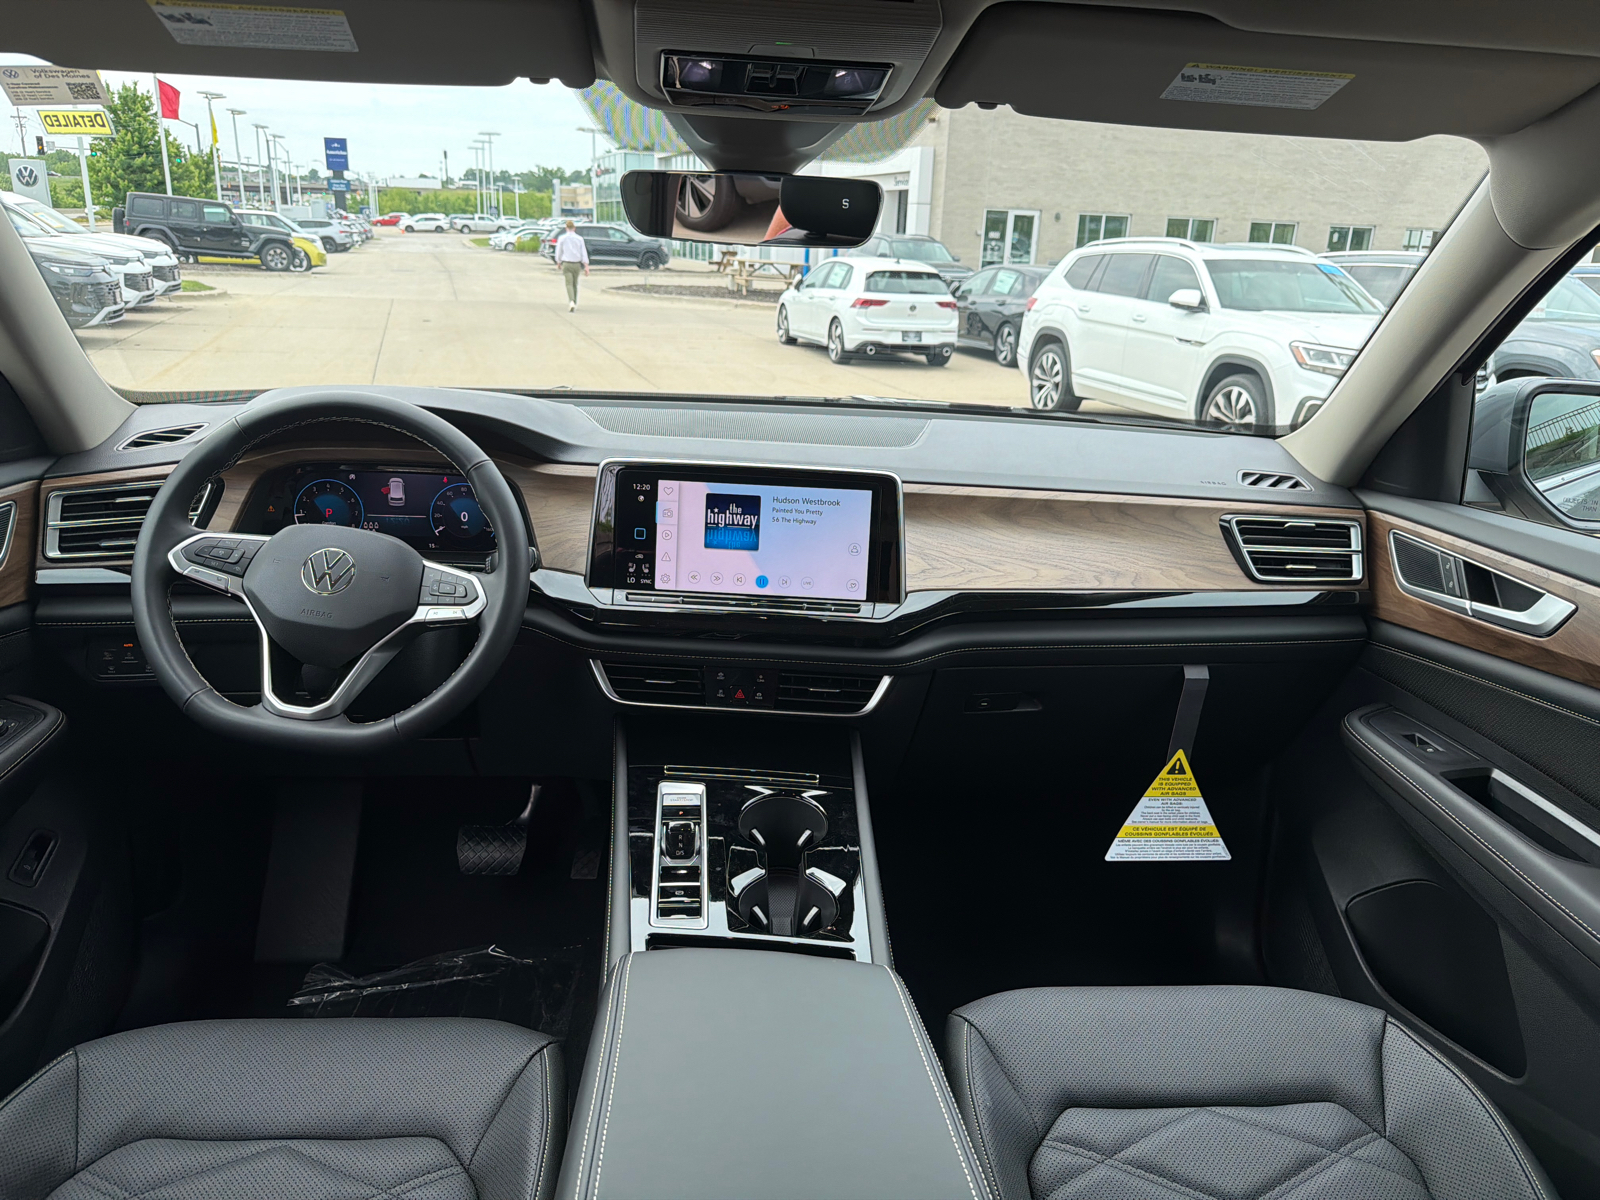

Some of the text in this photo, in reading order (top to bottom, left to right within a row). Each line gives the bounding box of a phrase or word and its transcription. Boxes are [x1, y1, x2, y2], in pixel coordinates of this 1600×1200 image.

[842, 198, 849, 209] S
[632, 483, 651, 491] 12:20
[772, 496, 841, 507] Hudson Westbrook
[325, 508, 333, 518] P
[729, 502, 743, 514] the
[772, 506, 823, 517] Painted You Pretty
[460, 511, 469, 522] 0
[707, 507, 758, 529] highway
[792, 517, 817, 526] Highway
[626, 576, 636, 584] LO
[300, 608, 333, 619] AIRBAG
